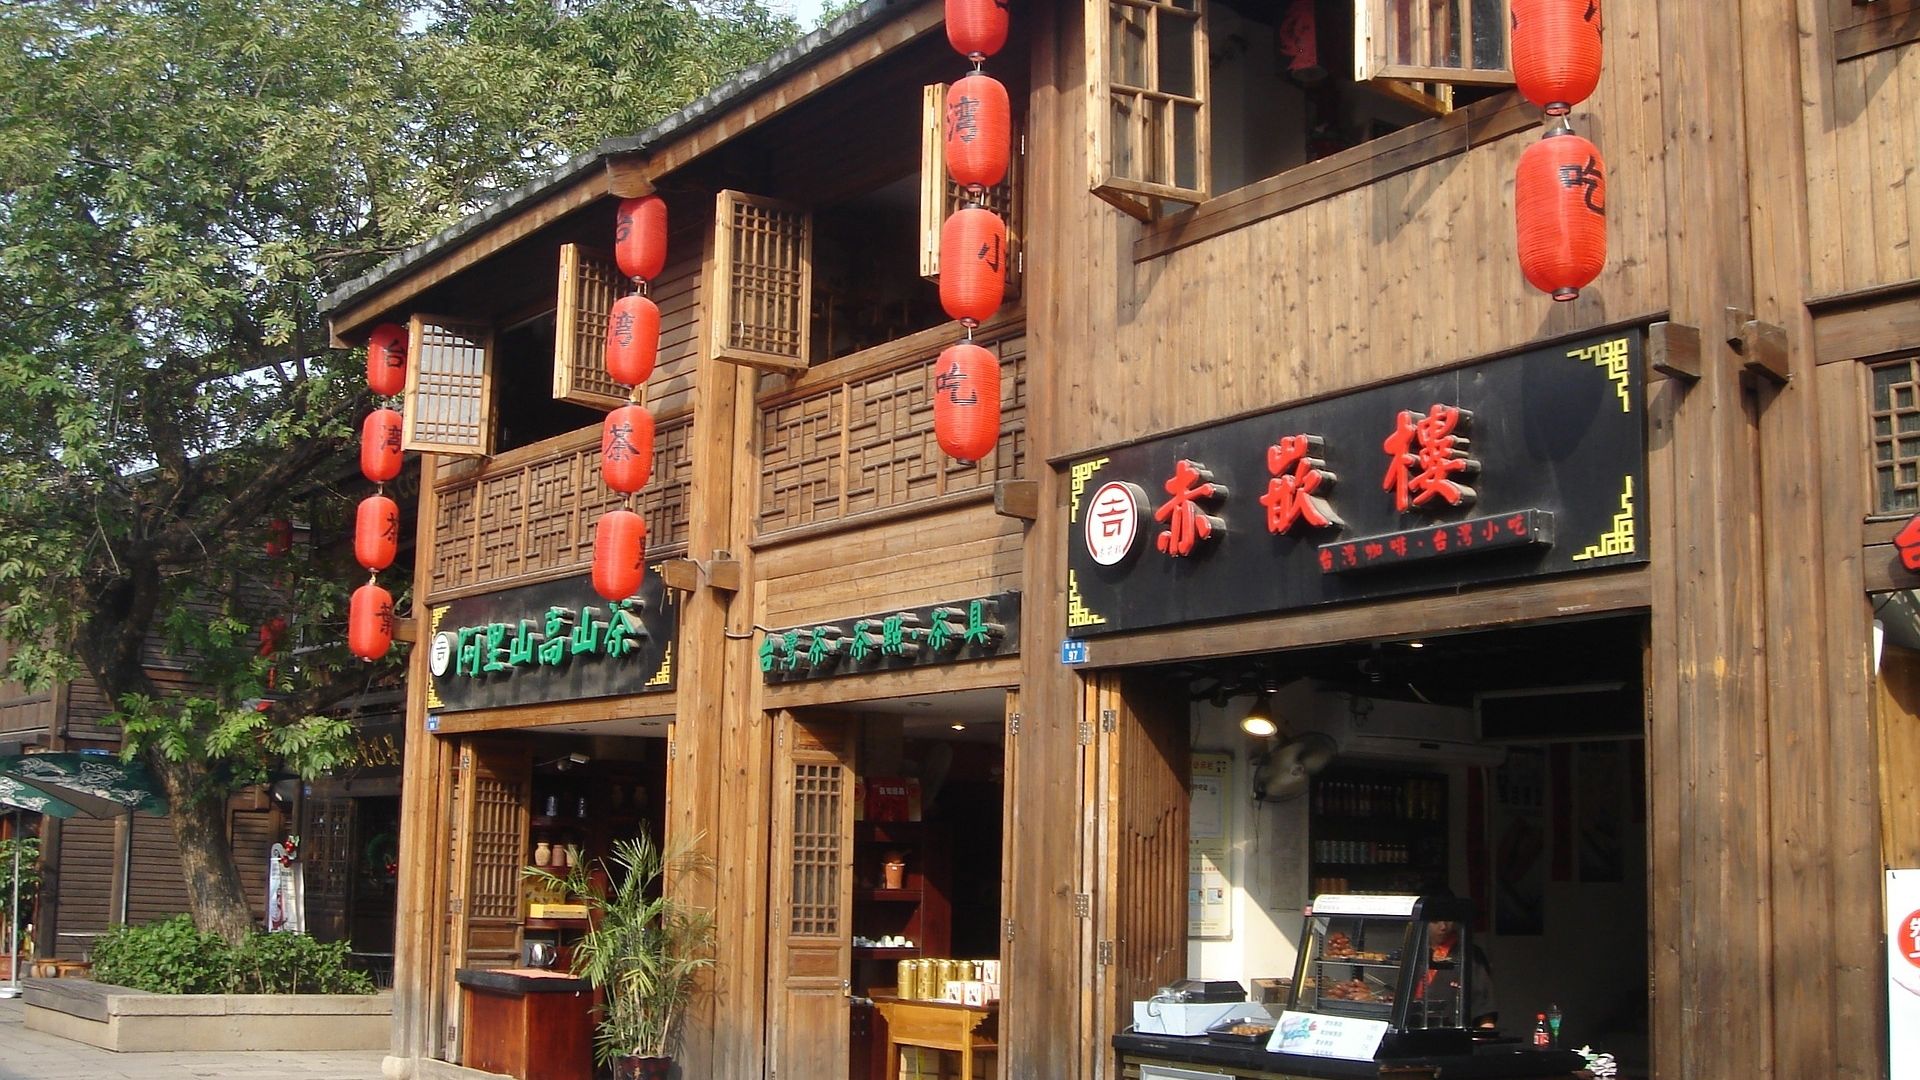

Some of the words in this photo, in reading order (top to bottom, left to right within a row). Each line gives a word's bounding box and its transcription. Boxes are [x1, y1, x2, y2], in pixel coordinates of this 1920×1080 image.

[455, 599, 640, 679] 阿里山高山茶
[1068, 650, 1079, 661] 97
